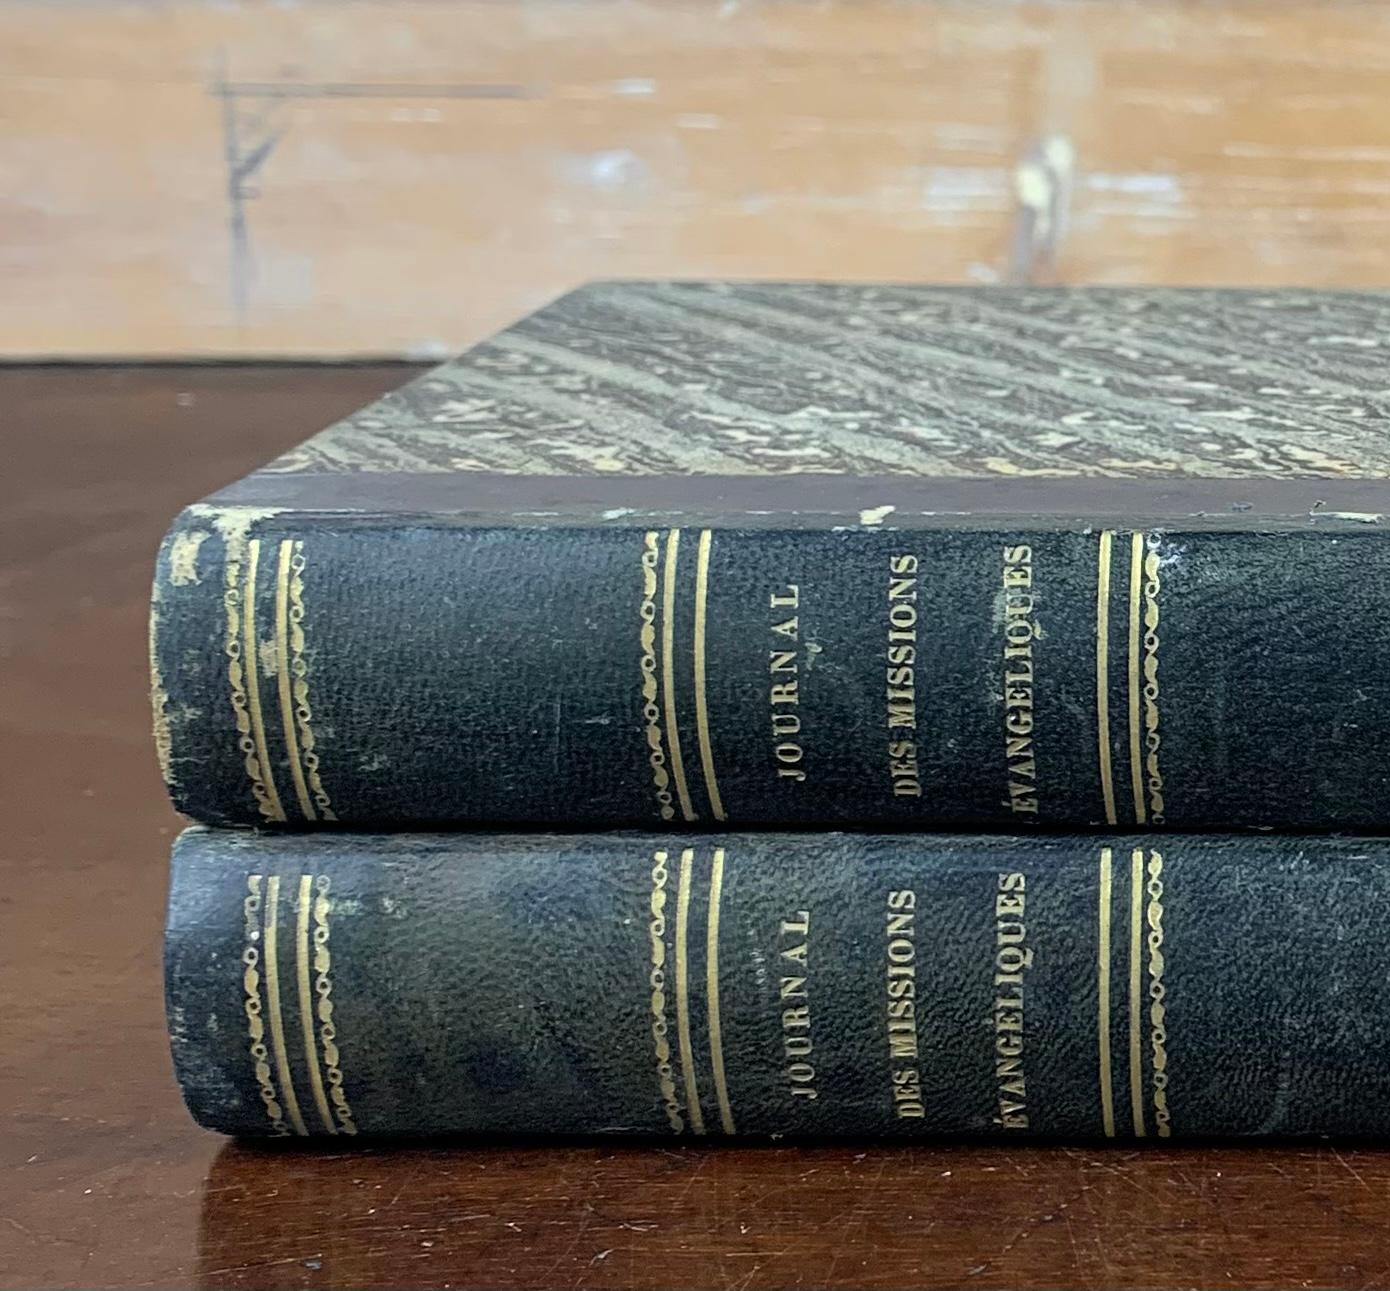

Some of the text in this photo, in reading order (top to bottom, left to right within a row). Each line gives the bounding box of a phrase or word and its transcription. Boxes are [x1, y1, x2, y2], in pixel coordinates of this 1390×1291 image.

[770, 584, 807, 782] JOURNAL
[886, 554, 922, 798] DES MISSIONS
[780, 910, 817, 1100] JOURNAL
[886, 889, 925, 1119] DES MISSIONS
